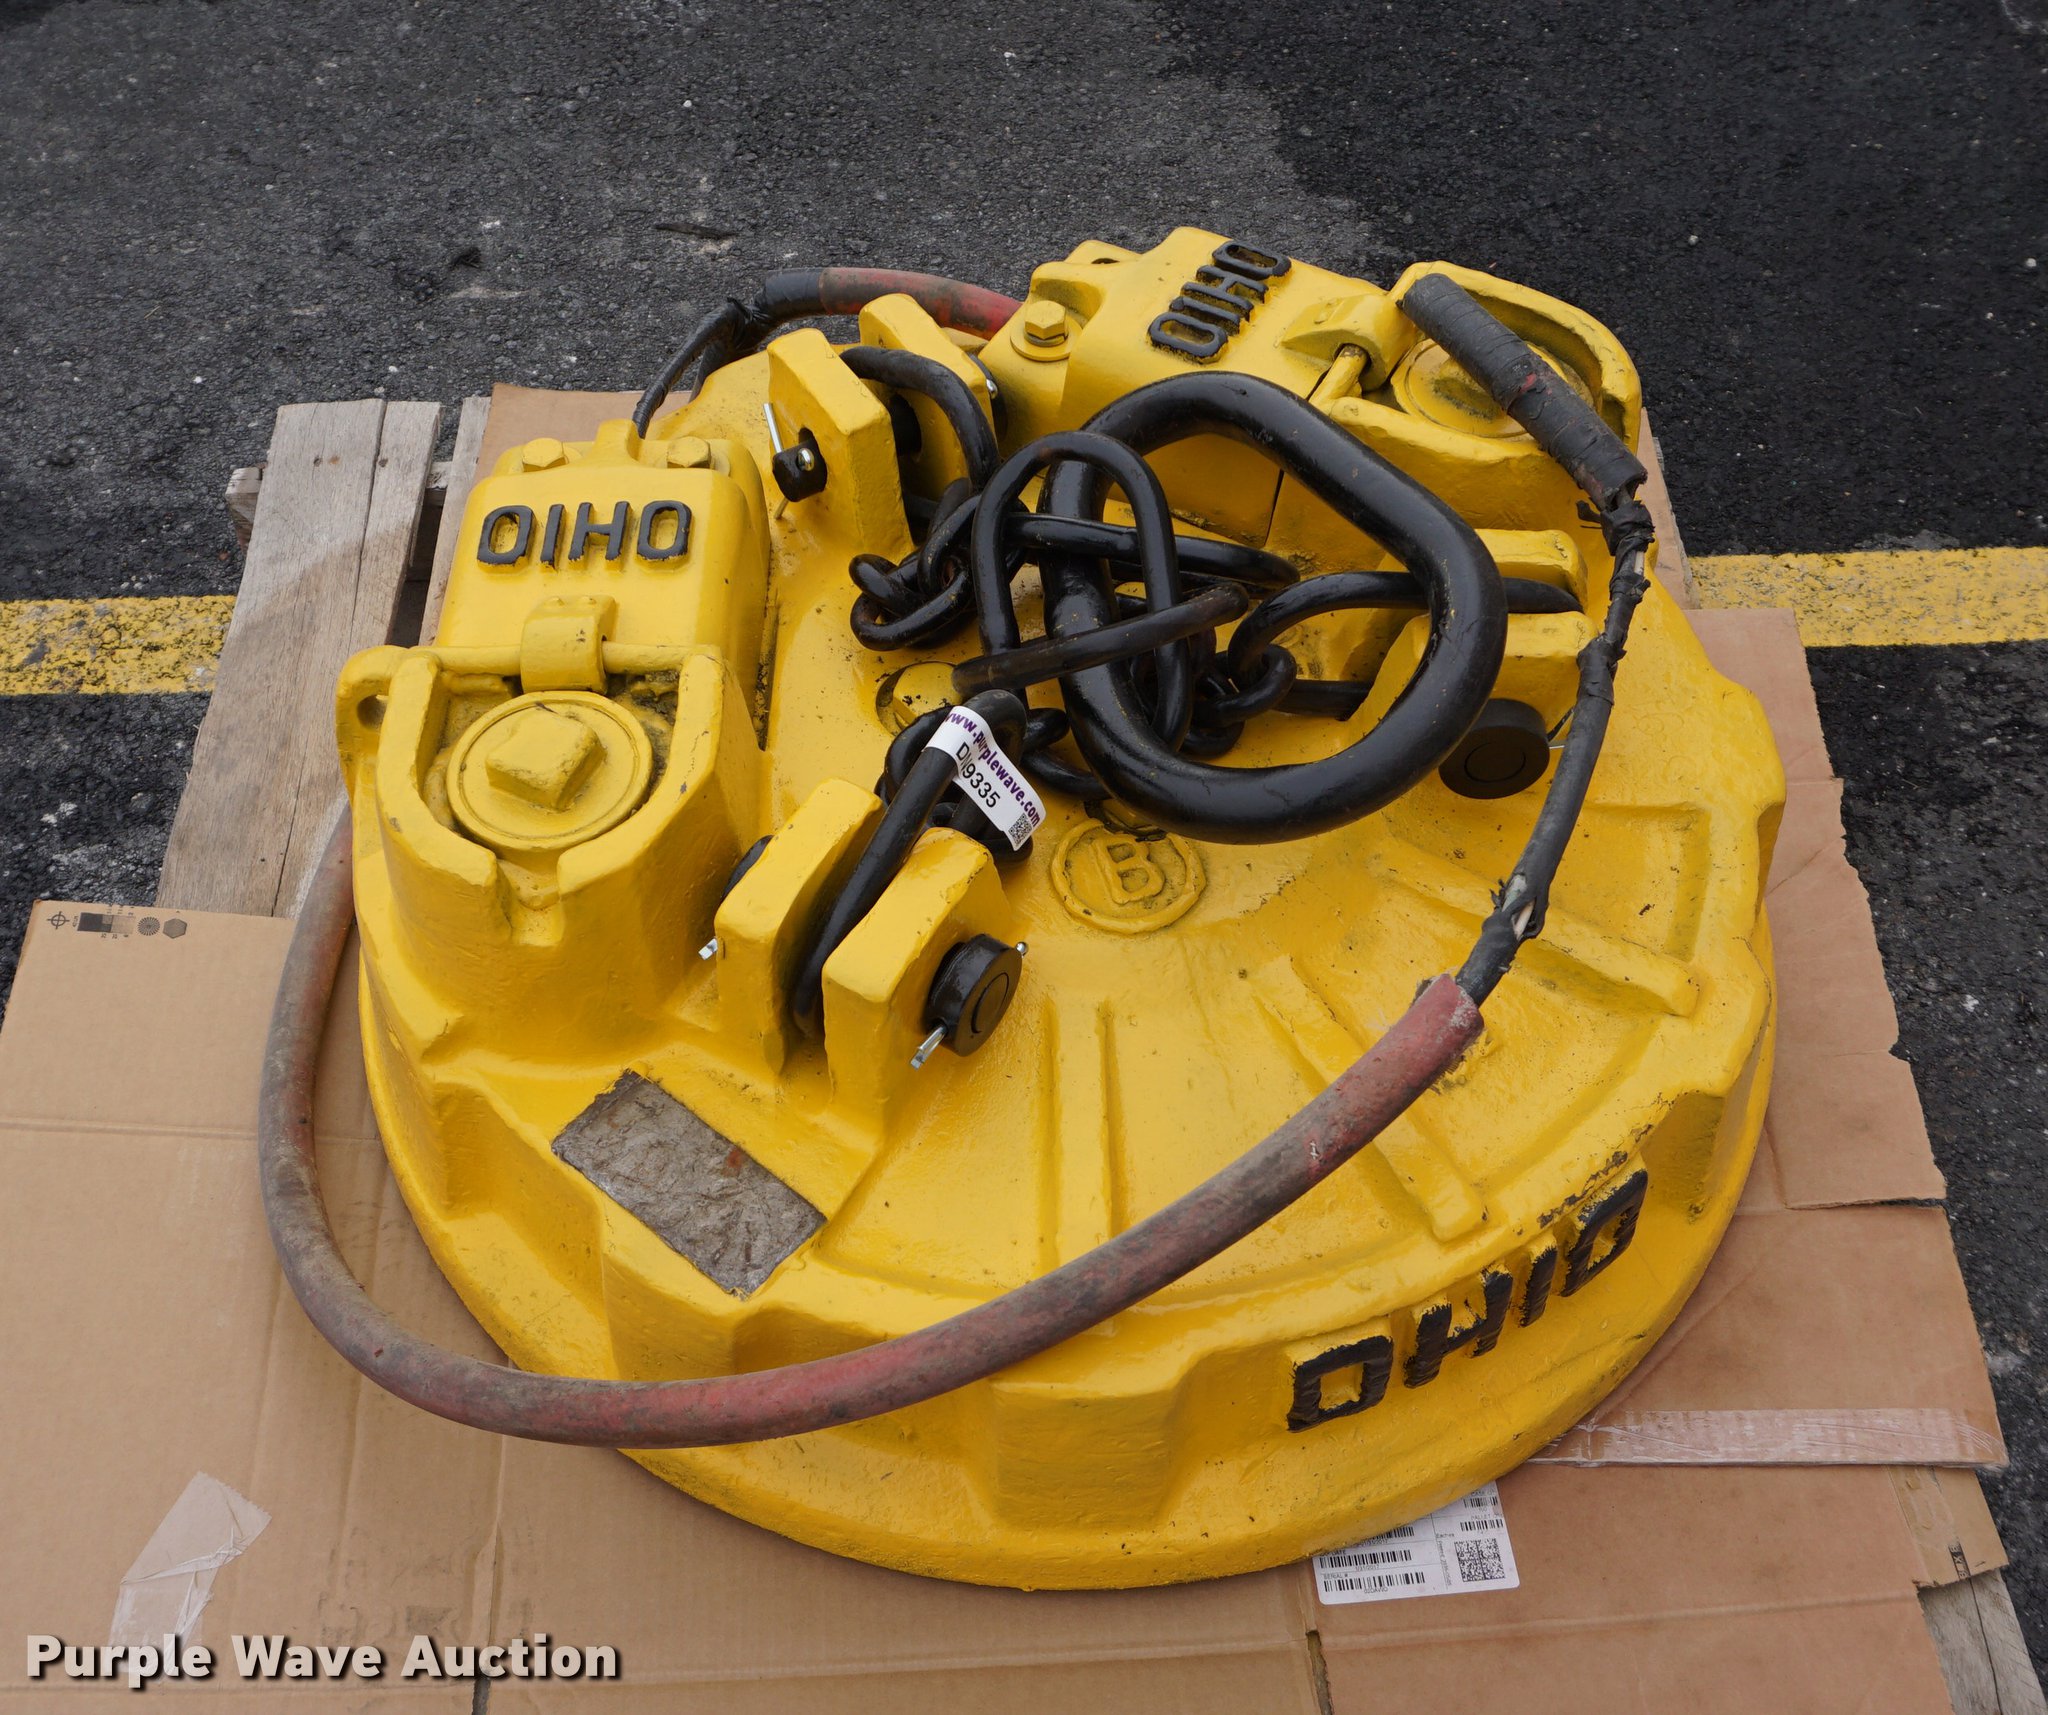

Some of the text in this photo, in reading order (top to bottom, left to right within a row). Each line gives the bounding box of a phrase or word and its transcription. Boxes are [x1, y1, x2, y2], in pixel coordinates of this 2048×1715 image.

[1147, 240, 1292, 364] OHIO
[477, 500, 692, 566] OHIO
[1286, 1168, 1648, 1433] OHIO
